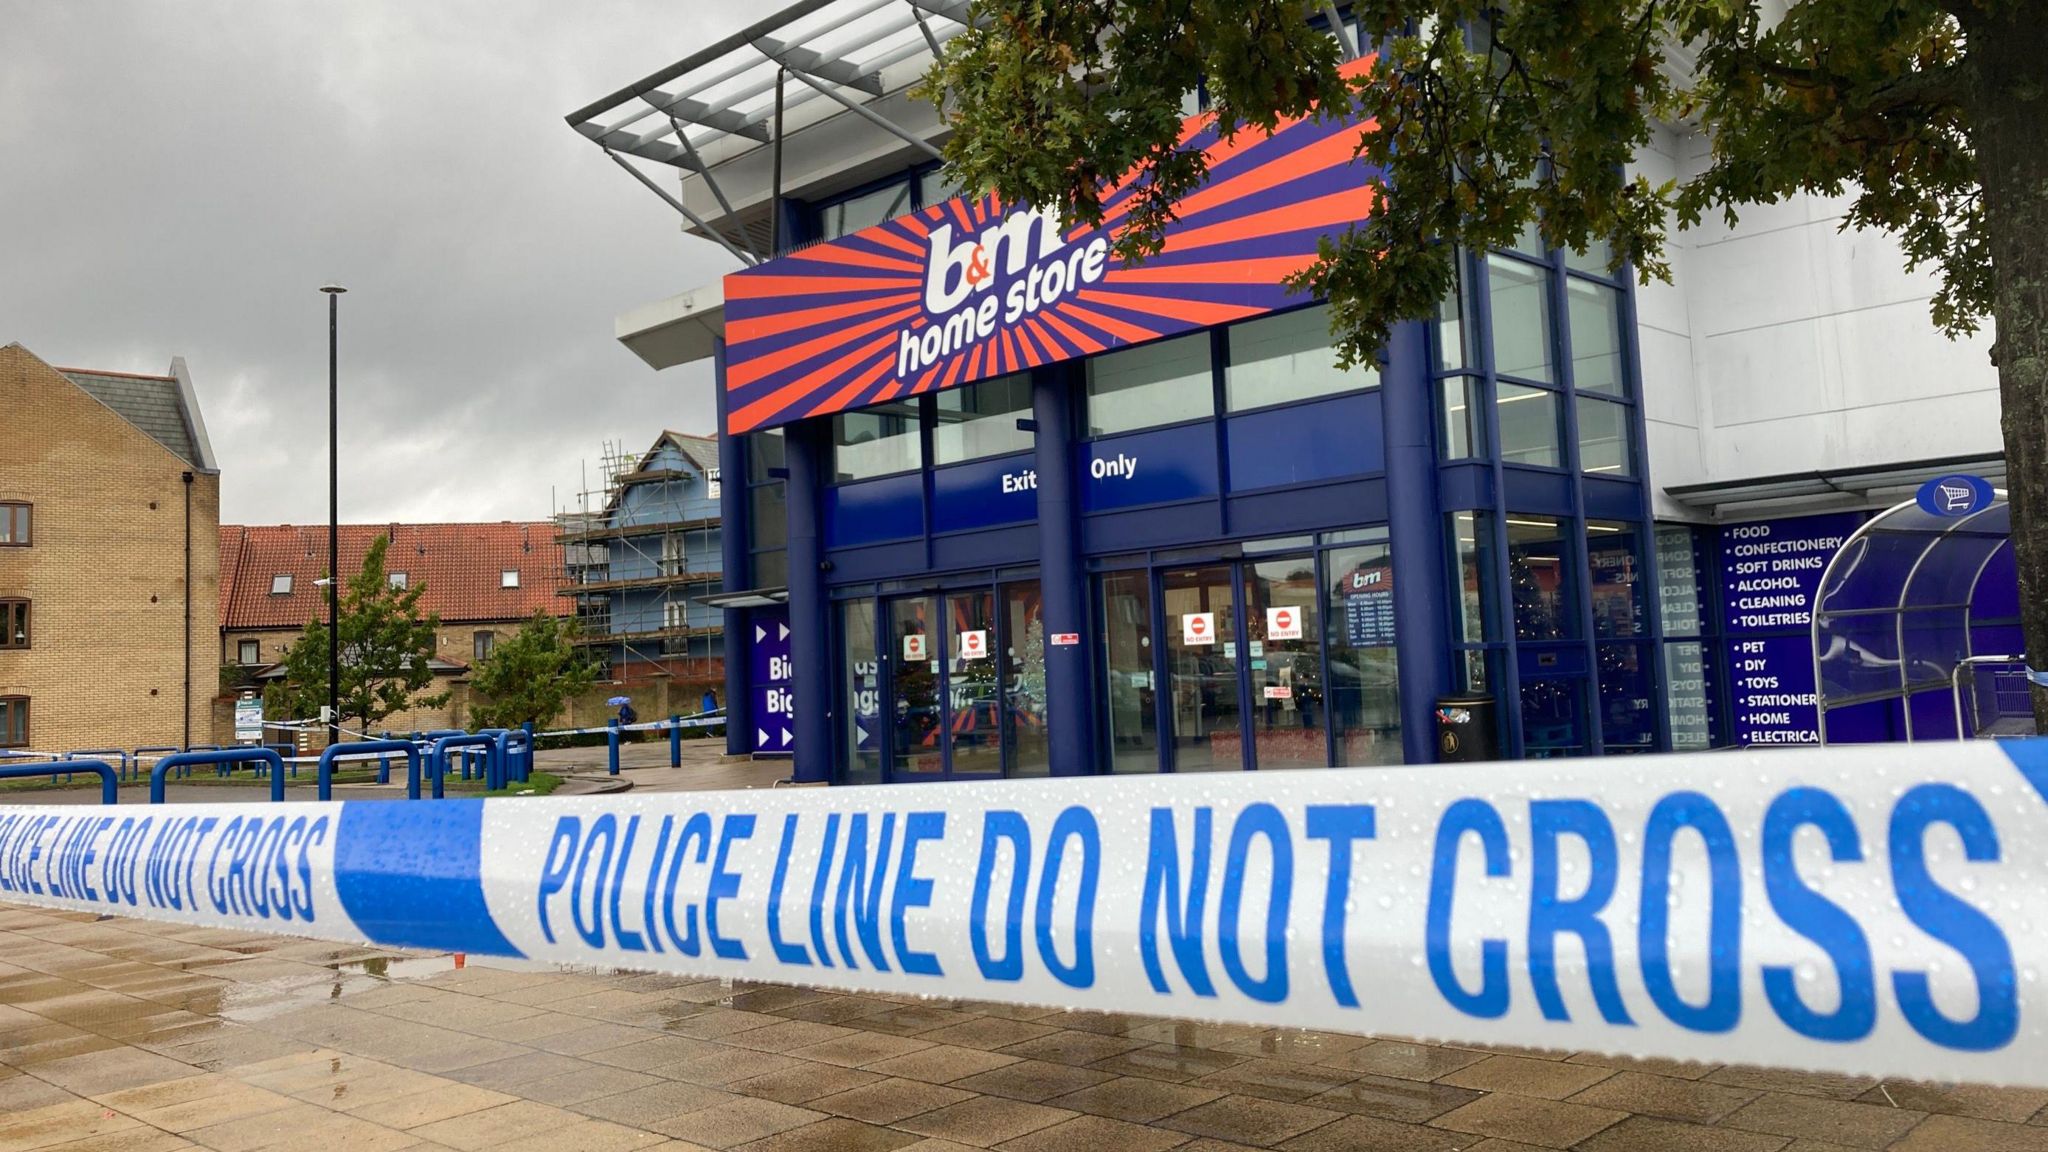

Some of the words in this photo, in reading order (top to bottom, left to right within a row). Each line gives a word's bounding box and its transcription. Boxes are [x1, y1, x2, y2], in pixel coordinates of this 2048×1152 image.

[898, 295, 999, 378] home
[1005, 238, 1107, 324] store
[1002, 470, 1037, 493] Exit
[1091, 453, 1137, 479] Only
[1733, 525, 1770, 539] FOOD
[1734, 536, 1843, 557] CONFECTIONERY
[1736, 561, 1768, 574] SOFT
[1772, 556, 1823, 571] DRINKS
[1737, 577, 1800, 592] ALCOHOL
[1739, 594, 1806, 609] CLEANING
[1740, 612, 1811, 627] TOILETRIES
[1743, 641, 1765, 653] PET
[1745, 659, 1766, 671] DIY
[1745, 676, 1779, 689] TOYS
[1747, 694, 1818, 707] STATIONER
[1749, 712, 1791, 724] HOME
[1751, 730, 1819, 742] ELECTRICA
[46, 816, 116, 902] LINE
[103, 816, 153, 906] DO
[145, 815, 221, 912] NOT
[208, 815, 329, 923] CROSS
[536, 812, 757, 961] POLICE
[767, 810, 947, 977] LINE
[970, 805, 1102, 989] DO
[1138, 801, 1379, 1008] NOT
[1425, 782, 2021, 1053] CROSS
